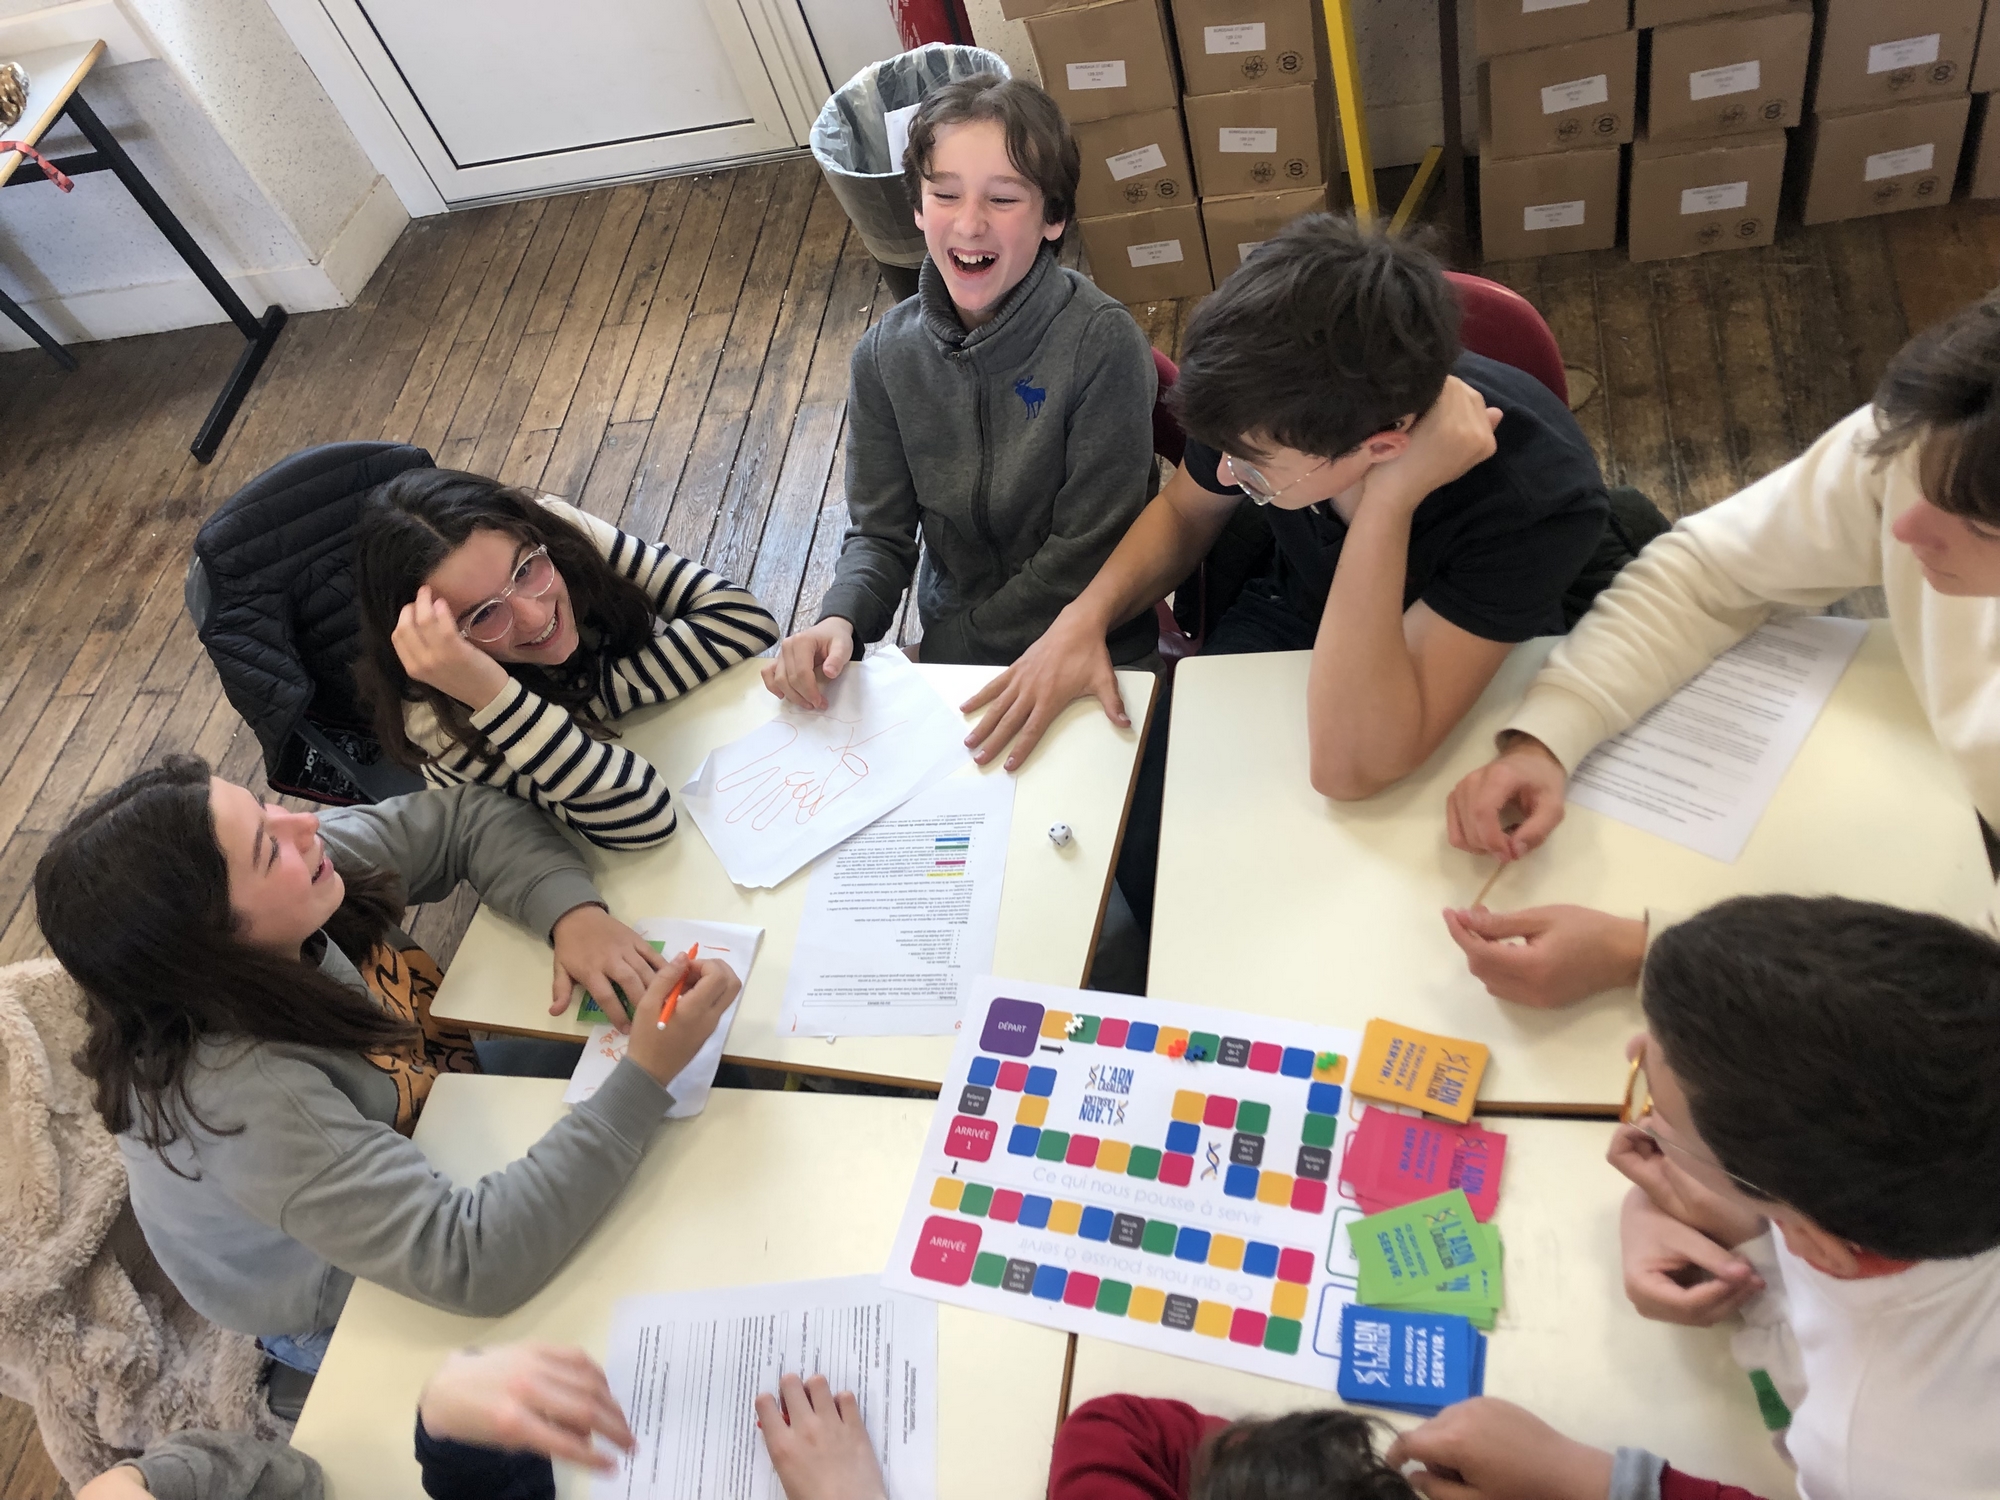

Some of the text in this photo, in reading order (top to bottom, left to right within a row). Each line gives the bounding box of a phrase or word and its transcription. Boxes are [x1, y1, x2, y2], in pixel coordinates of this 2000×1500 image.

[998, 1021, 1027, 1033] DÉPART
[1381, 1037, 1403, 1078] SERVIR
[955, 1125, 990, 1140] ARRIVÉE
[966, 1140, 971, 1150] 1
[1033, 1166, 1263, 1227] Ce qui nous pousse à servir
[929, 1236, 967, 1253] ARRIVÉE
[1020, 1237, 1060, 1256] servir
[1377, 1231, 1402, 1279] SERVIR
[1394, 1227, 1414, 1268] POUSSE
[941, 1253, 948, 1263] 2
[1082, 1249, 1143, 1275] pousse
[1147, 1265, 1188, 1286] nous
[1193, 1272, 1221, 1293] qui
[1226, 1283, 1253, 1301] Ce
[1353, 1320, 1378, 1368] L'ADN
[1376, 1323, 1391, 1369] LASALLIEN
[1404, 1325, 1414, 1386] CE QUI NOUS
[1416, 1339, 1427, 1387] POUSSE
[1431, 1334, 1445, 1388] SERVIR
